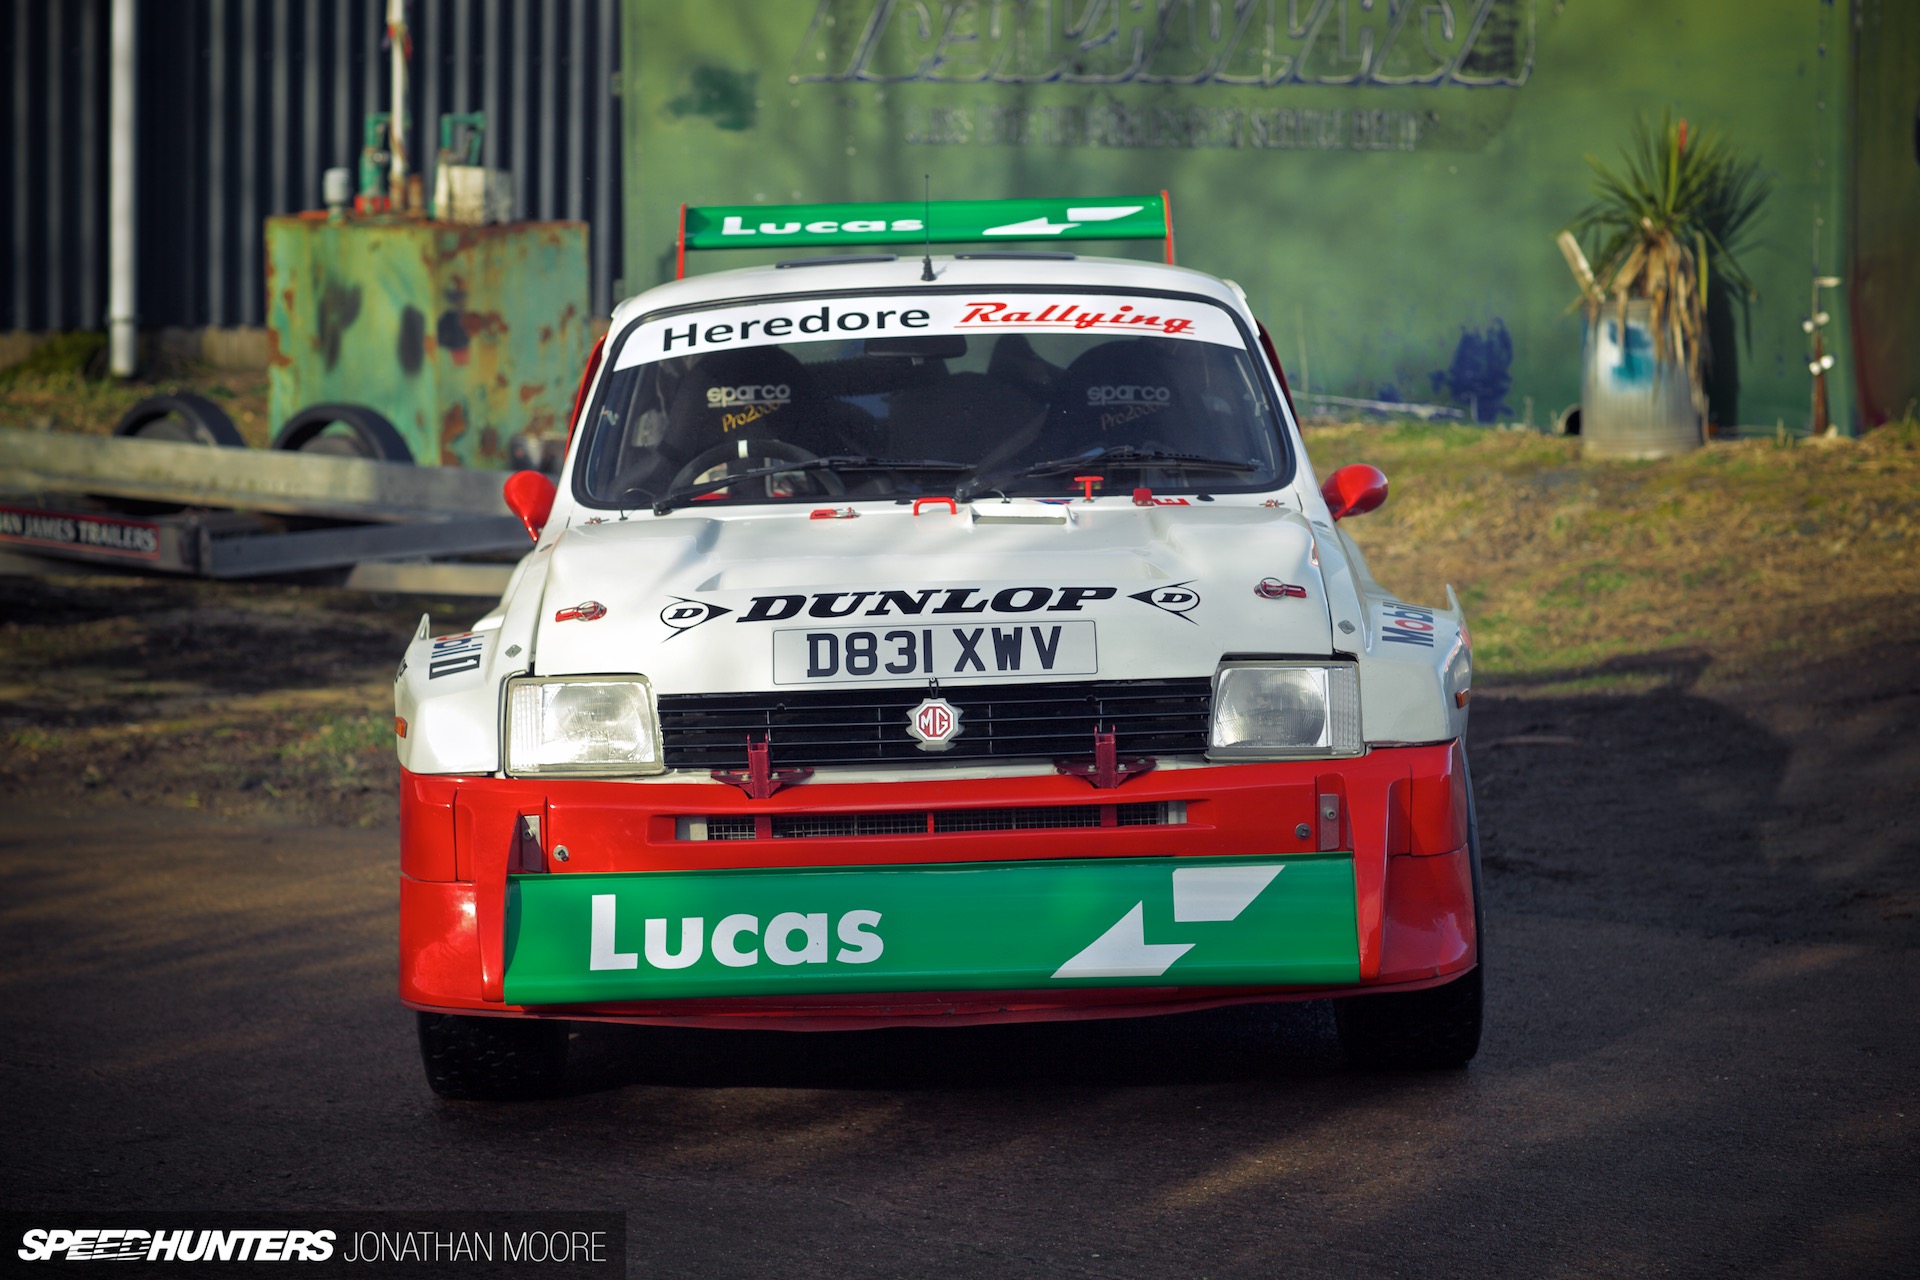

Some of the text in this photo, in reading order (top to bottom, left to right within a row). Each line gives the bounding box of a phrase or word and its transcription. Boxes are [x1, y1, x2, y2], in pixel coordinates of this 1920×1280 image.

[722, 216, 924, 236] Lucas
[662, 302, 1195, 351] Heredore Rallying
[706, 384, 791, 407] sparco
[1086, 384, 1171, 406] sparco
[78, 520, 157, 553] TRAILERS
[736, 587, 1118, 623] DUNLOP
[1381, 601, 1434, 648] Mobil
[806, 626, 1063, 678] D831 XWV
[919, 707, 950, 736] MG
[590, 894, 884, 971] Lucas
